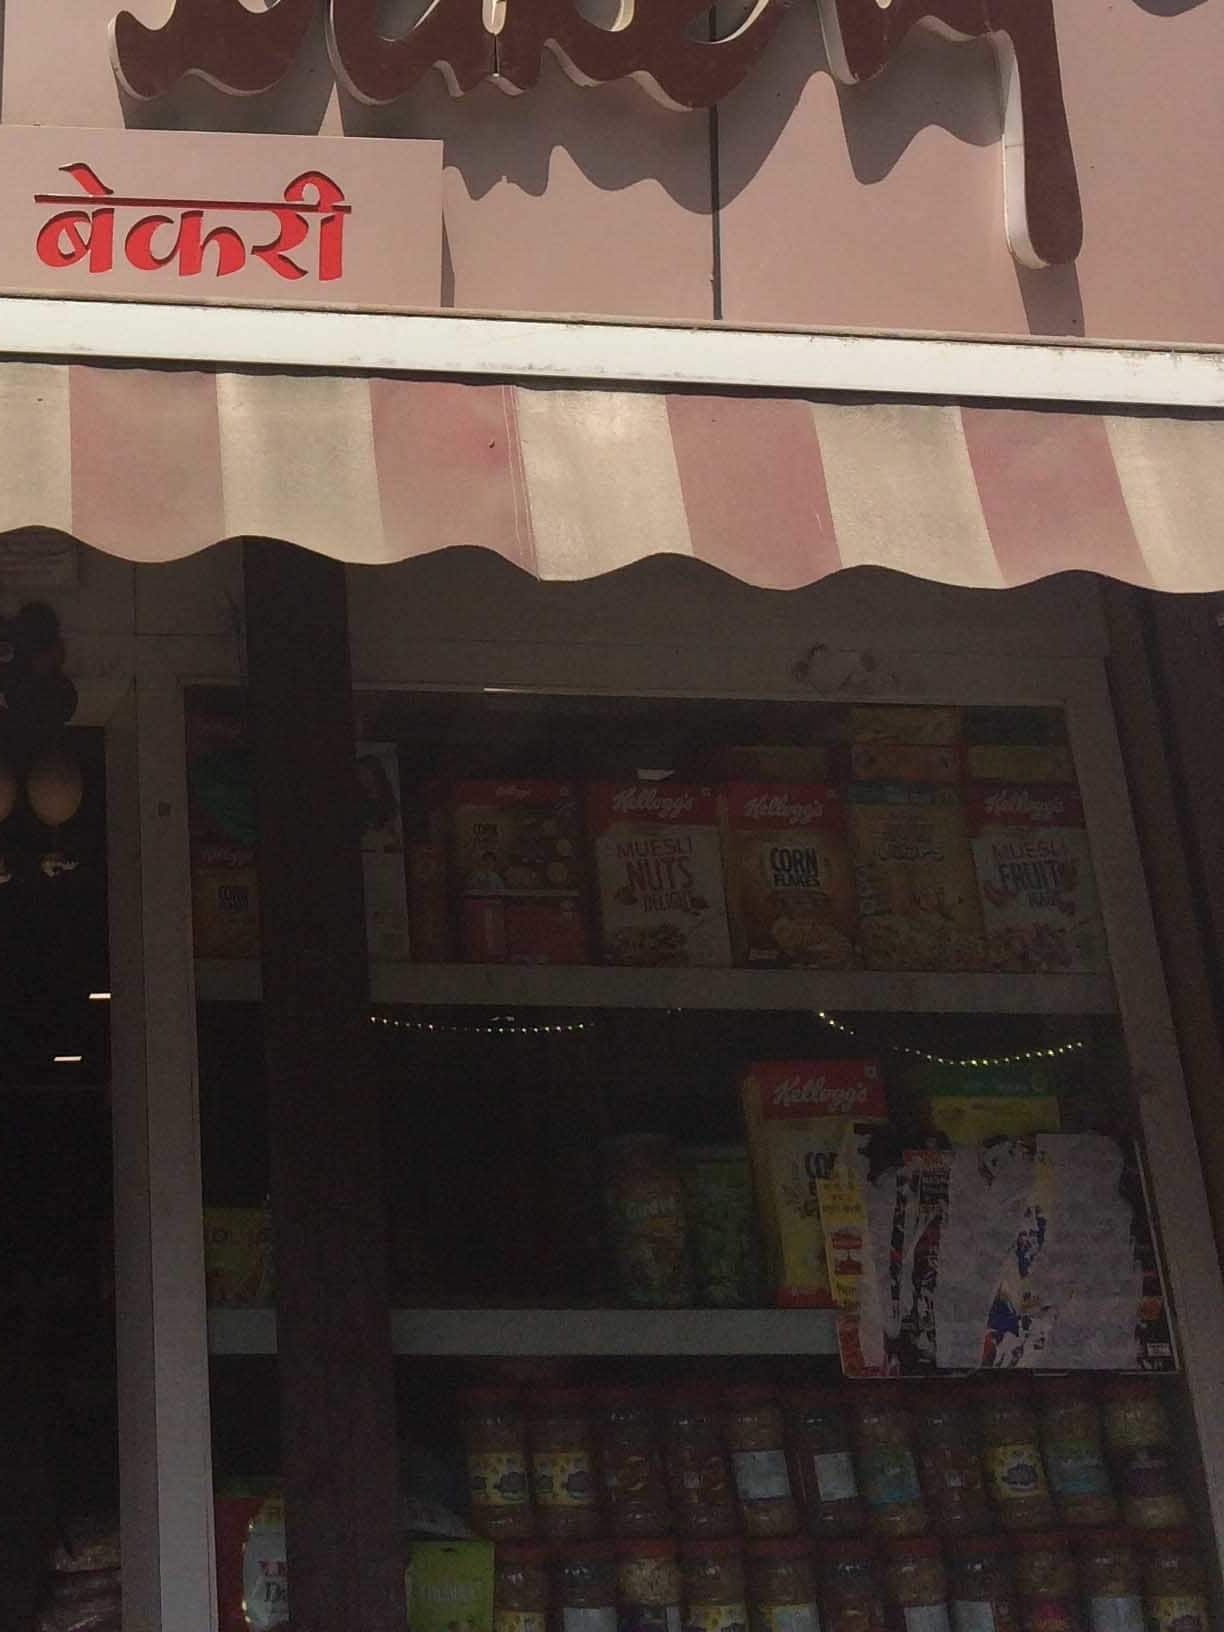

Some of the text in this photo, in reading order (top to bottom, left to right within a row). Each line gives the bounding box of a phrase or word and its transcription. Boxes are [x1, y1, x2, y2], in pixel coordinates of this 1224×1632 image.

[34, 162, 352, 282] बेकरी
[612, 782, 695, 819] Kellogg's
[770, 847, 819, 872] CORN
[773, 1075, 869, 1114] Kellogg's
